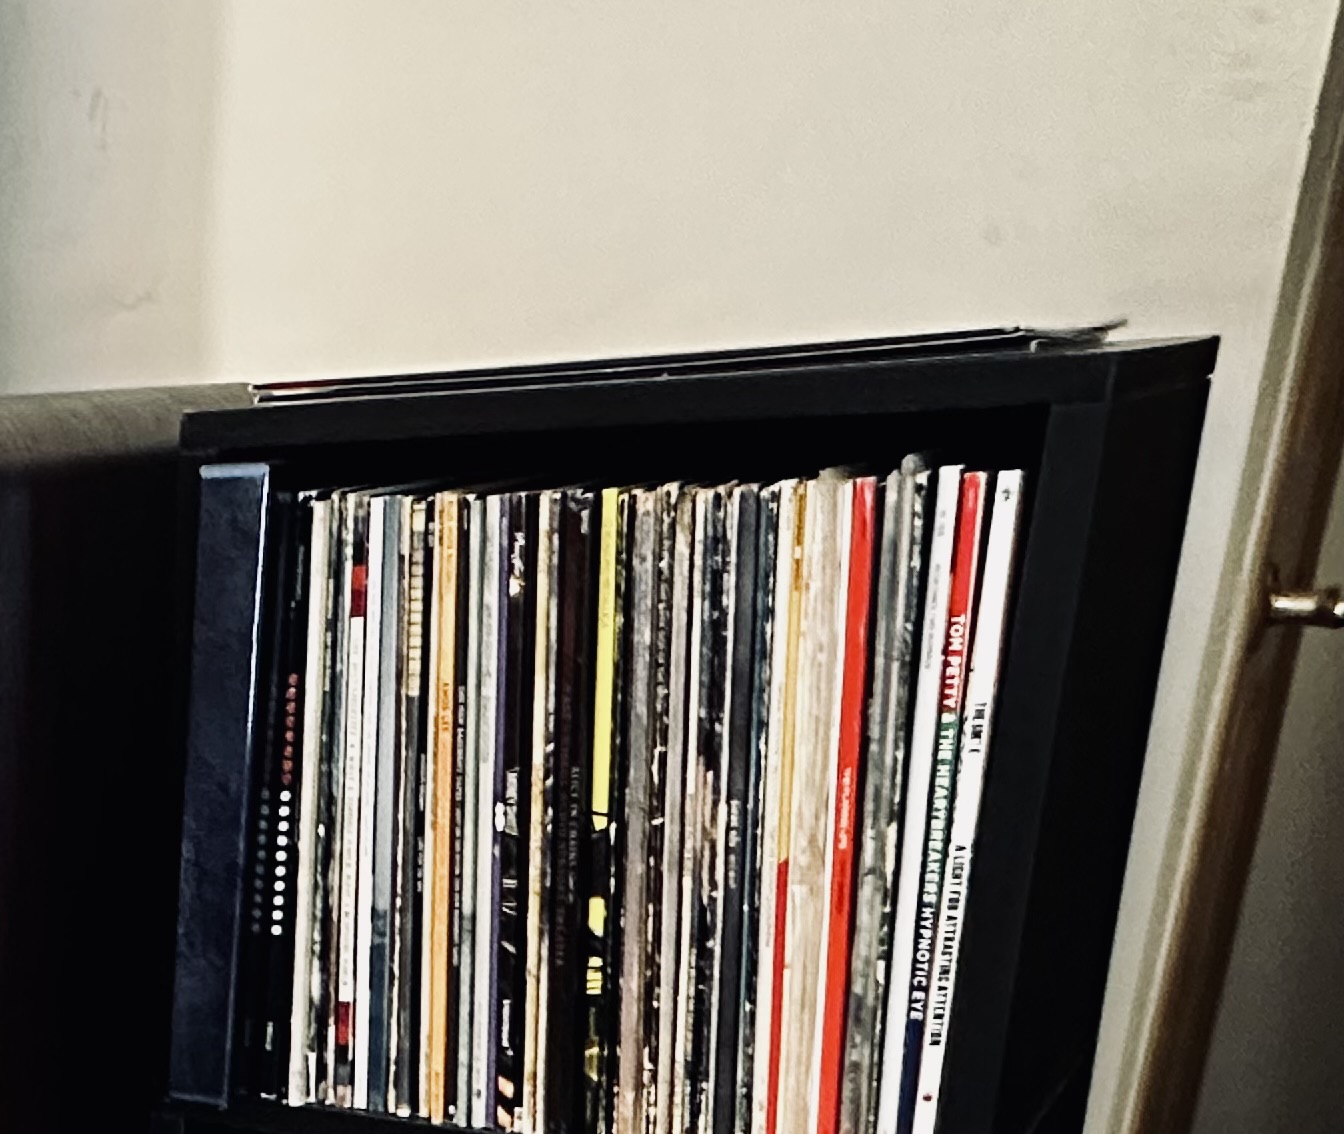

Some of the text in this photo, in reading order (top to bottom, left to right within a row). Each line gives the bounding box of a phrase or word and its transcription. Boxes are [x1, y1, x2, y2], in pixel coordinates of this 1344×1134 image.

[948, 614, 965, 651] TOM
[942, 655, 962, 708] PETTY
[937, 728, 954, 761] THE
[922, 764, 951, 904] HEARTBREAKERS
[912, 907, 933, 987] HYPNOTIC
[909, 990, 925, 1020] EYE
